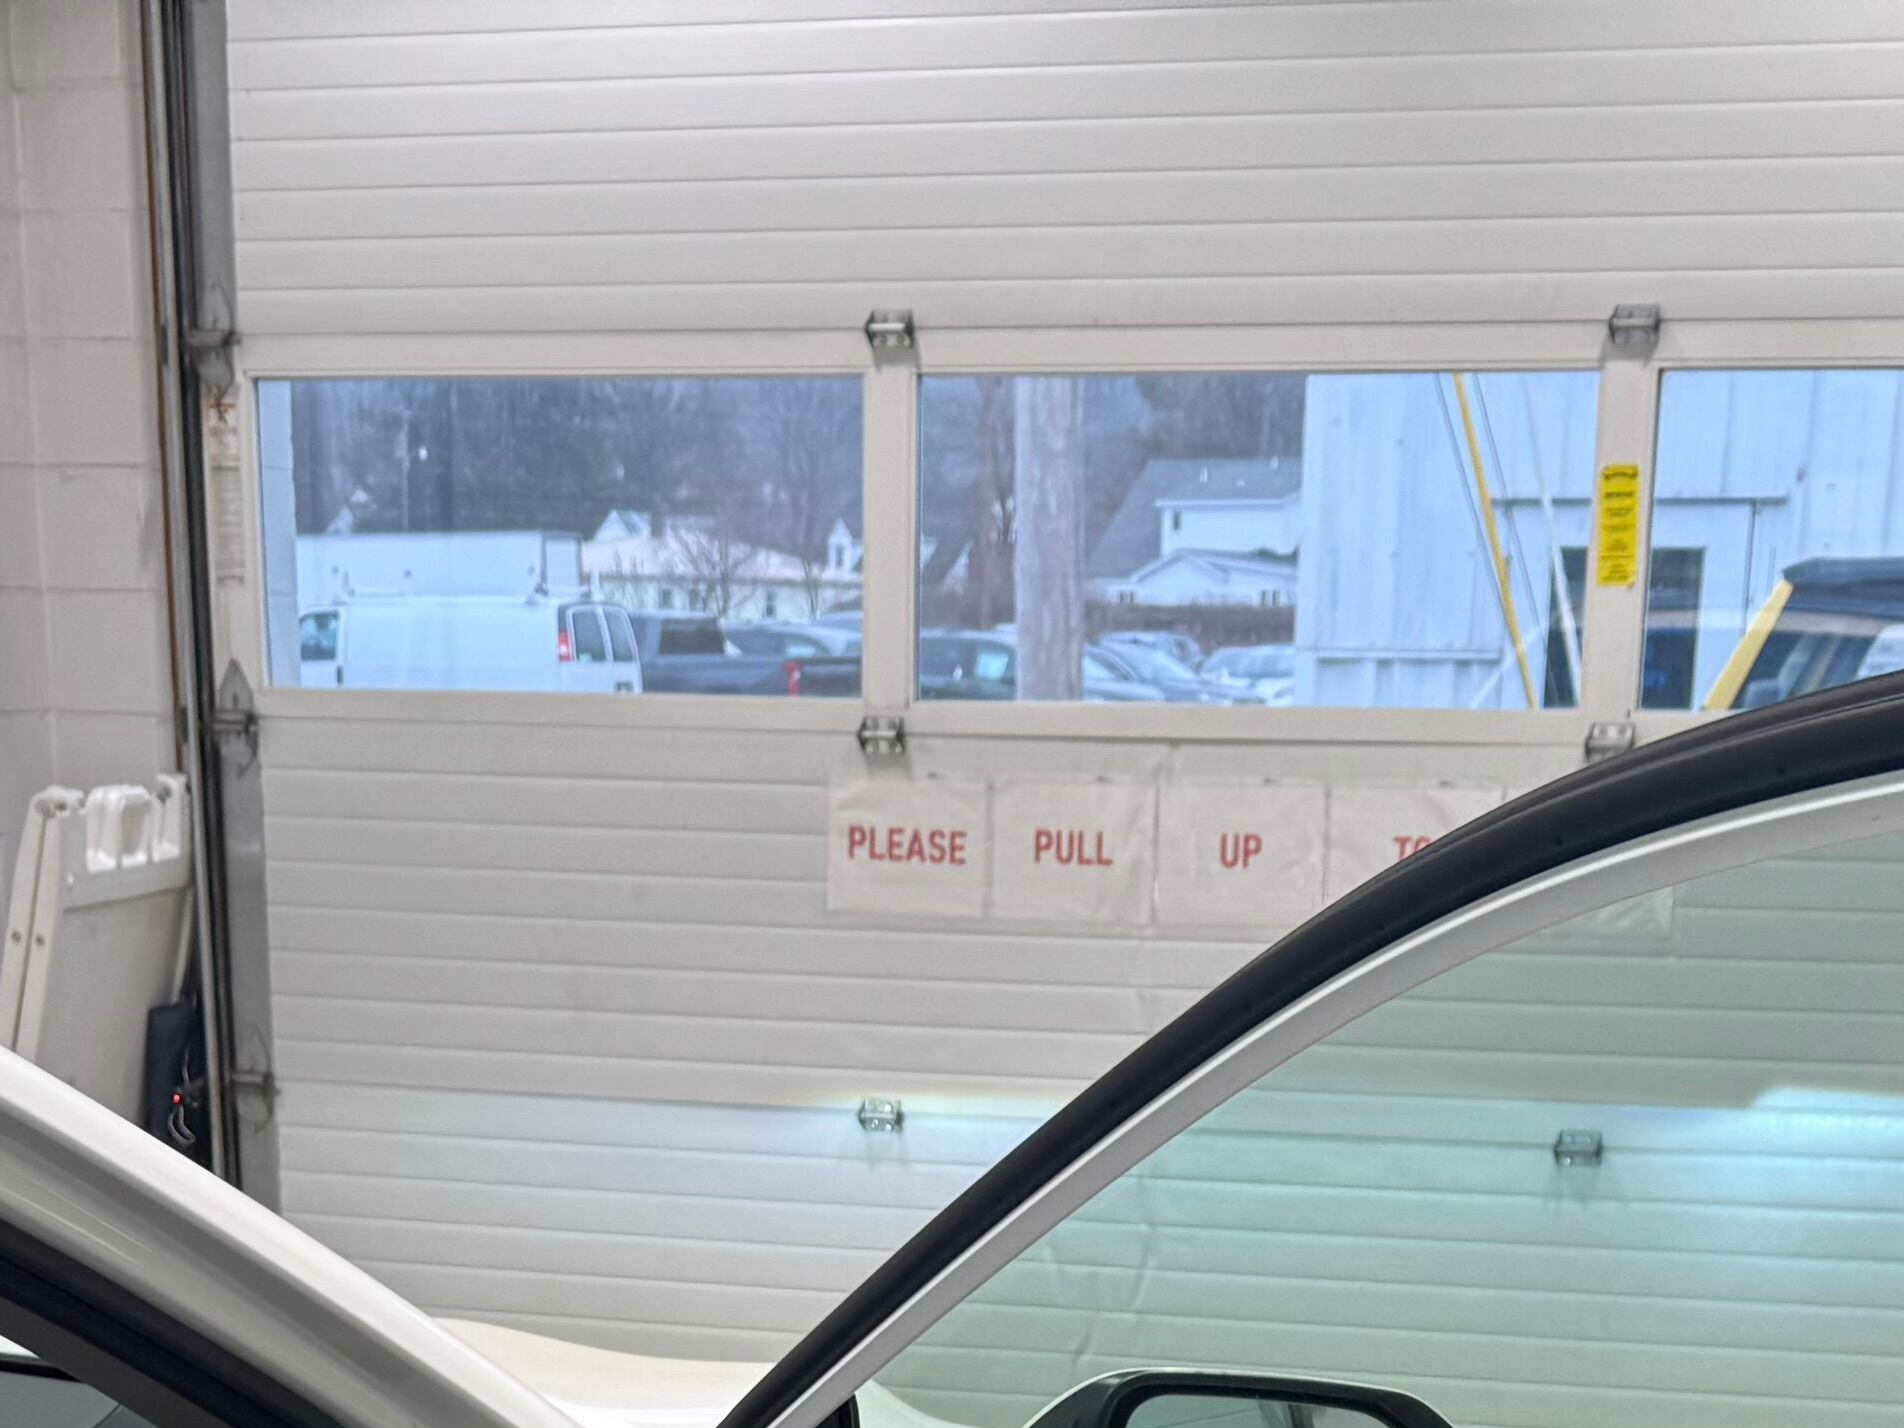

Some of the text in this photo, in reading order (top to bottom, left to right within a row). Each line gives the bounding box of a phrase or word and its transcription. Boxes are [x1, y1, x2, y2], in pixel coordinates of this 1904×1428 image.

[847, 824, 967, 866] PLEASE
[1033, 826, 1113, 868] PULL
[1219, 832, 1264, 870] UP
